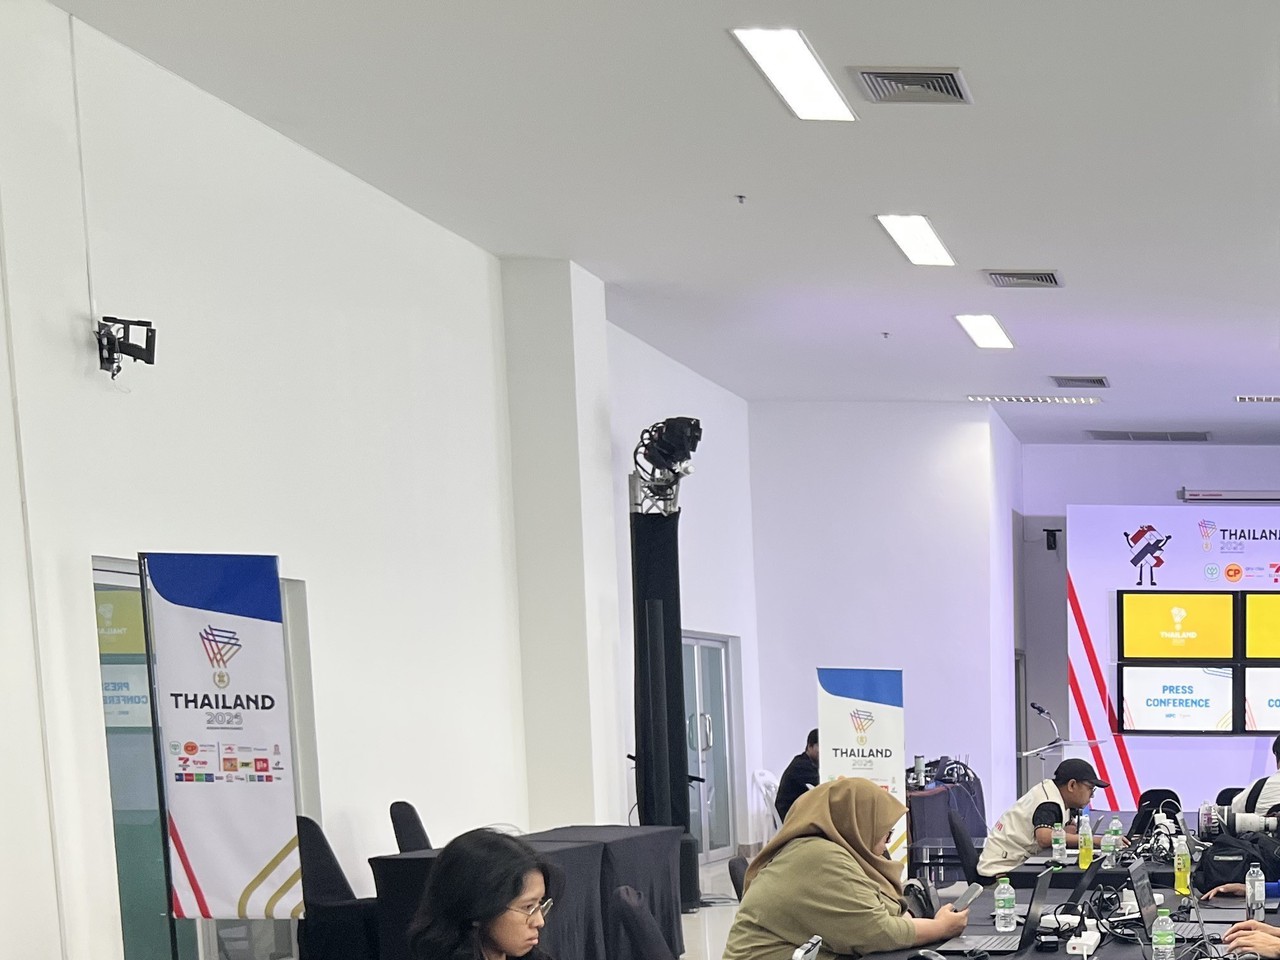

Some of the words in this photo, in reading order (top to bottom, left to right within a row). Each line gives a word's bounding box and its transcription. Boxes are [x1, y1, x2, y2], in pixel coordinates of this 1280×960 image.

[1226, 568, 1241, 578] CP
[1160, 631, 1197, 639] THAILAND
[1162, 685, 1194, 694] PRESS
[170, 693, 275, 710] THAILAND
[1146, 698, 1210, 708] CONFERENCE
[205, 712, 243, 725] 2025
[832, 748, 892, 758] THAILAND
